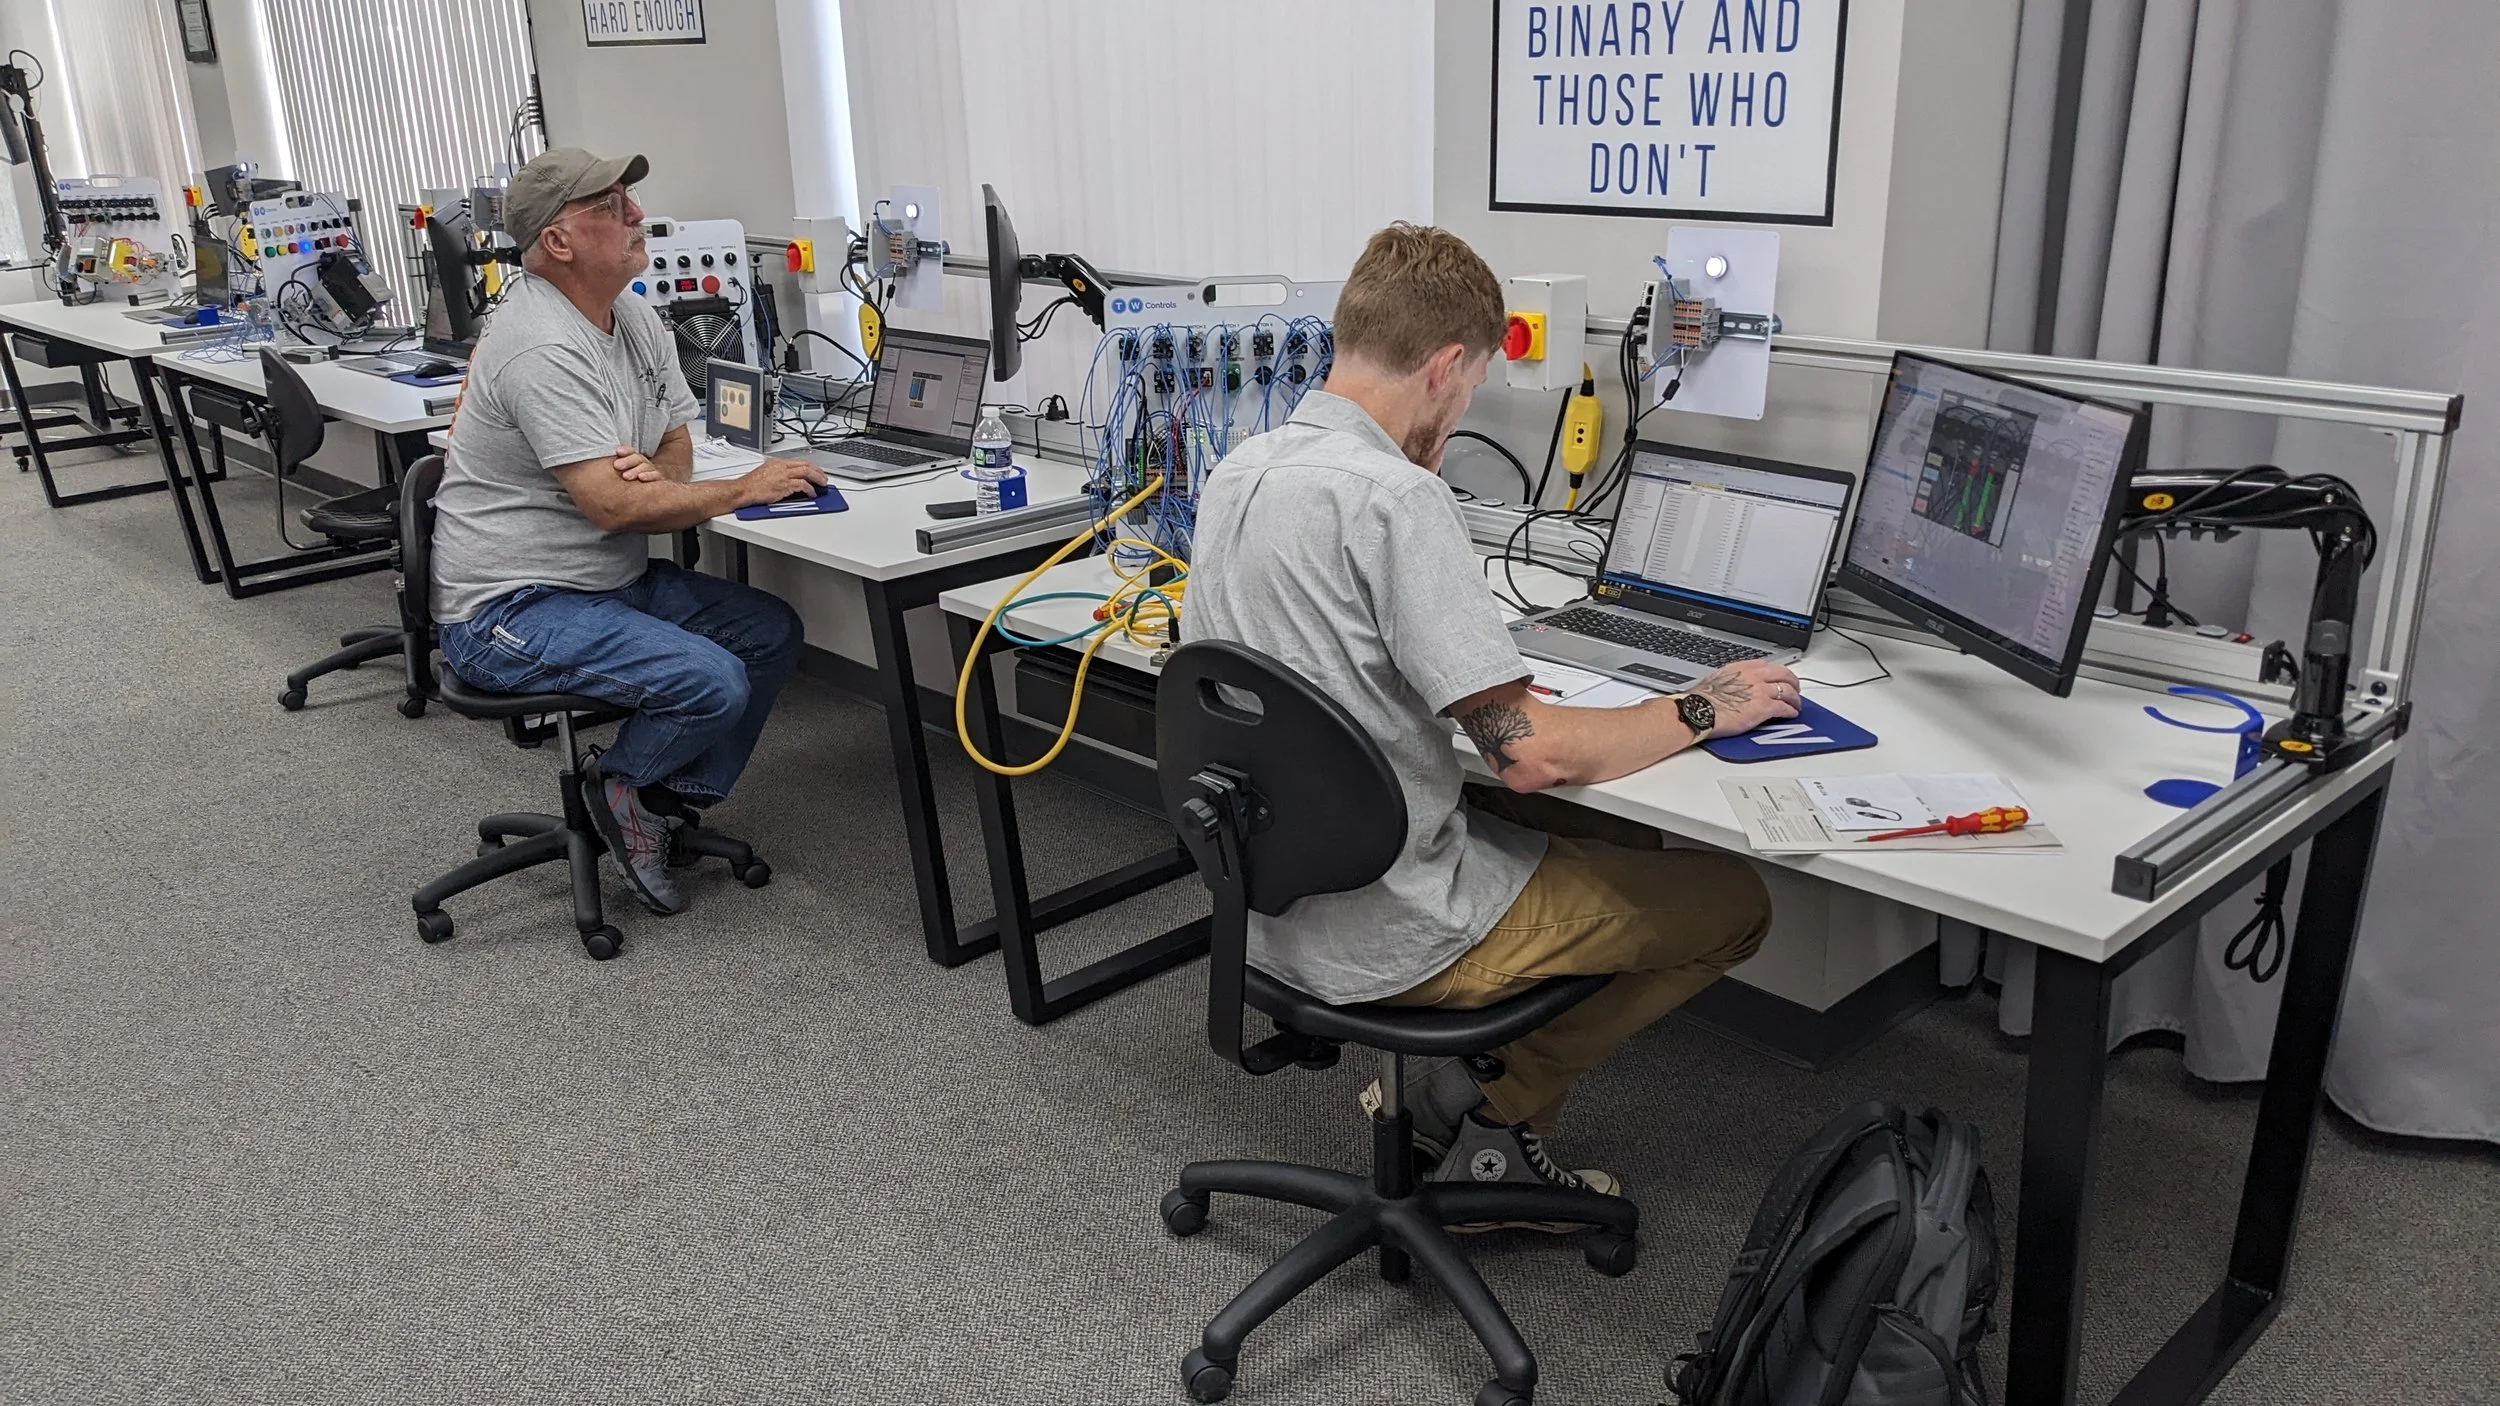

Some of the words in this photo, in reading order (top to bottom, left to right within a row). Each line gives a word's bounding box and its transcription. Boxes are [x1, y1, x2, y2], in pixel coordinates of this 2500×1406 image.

[588, 2, 629, 34] HARD
[634, 0, 696, 32] ENOUGH
[1527, 0, 1684, 58] BINARY
[1707, 0, 1801, 54] AND
[1533, 72, 1664, 126] THOSE
[1689, 71, 1788, 128] WHO
[1589, 142, 1716, 197] DON'T
[1145, 301, 1177, 310] Controls
